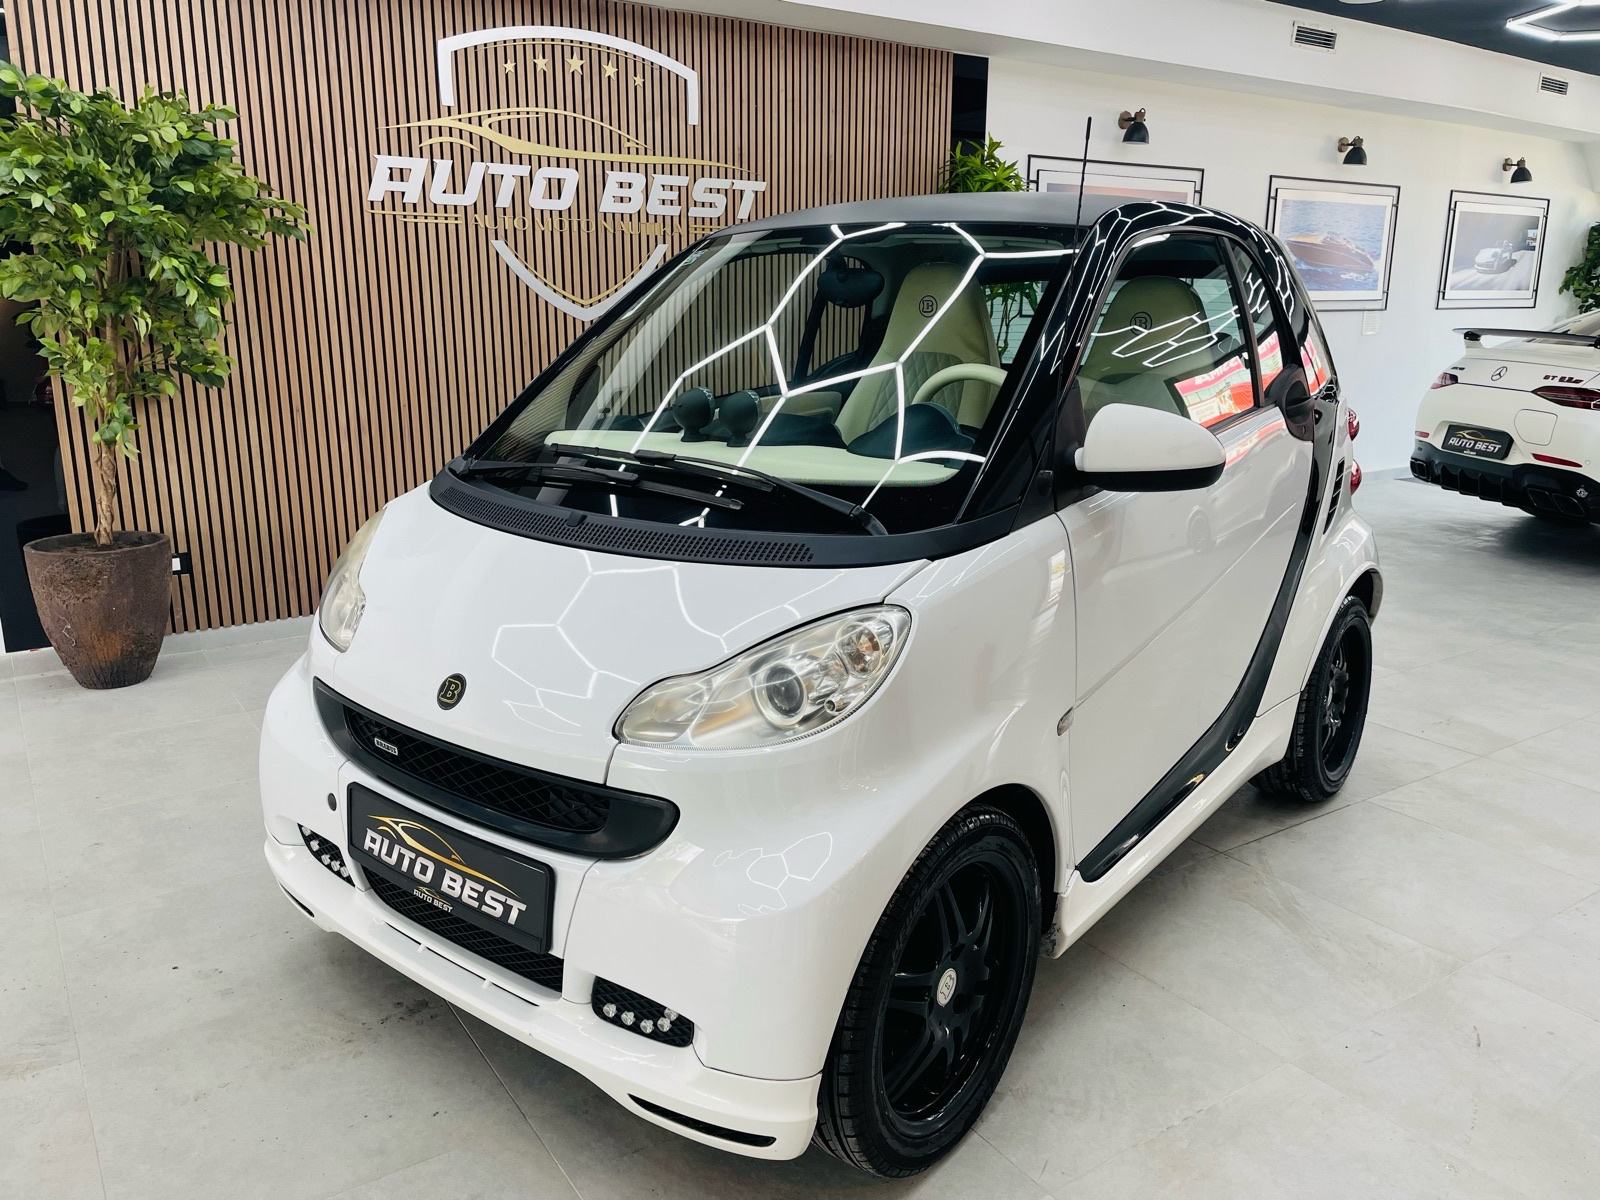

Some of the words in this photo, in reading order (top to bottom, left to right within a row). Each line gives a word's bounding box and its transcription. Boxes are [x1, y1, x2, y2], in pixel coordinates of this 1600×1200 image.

[366, 154, 580, 211] AUTO
[599, 170, 768, 220] BEST
[471, 213, 529, 231] AUTO
[535, 217, 595, 234] MOTO
[1448, 437, 1475, 449] AUTO
[1474, 441, 1502, 453] BEST
[439, 677, 462, 704] B
[363, 827, 435, 884] AUTO
[440, 868, 527, 925] BEST
[413, 888, 433, 903] AUTO
[433, 899, 453, 913] BEST
